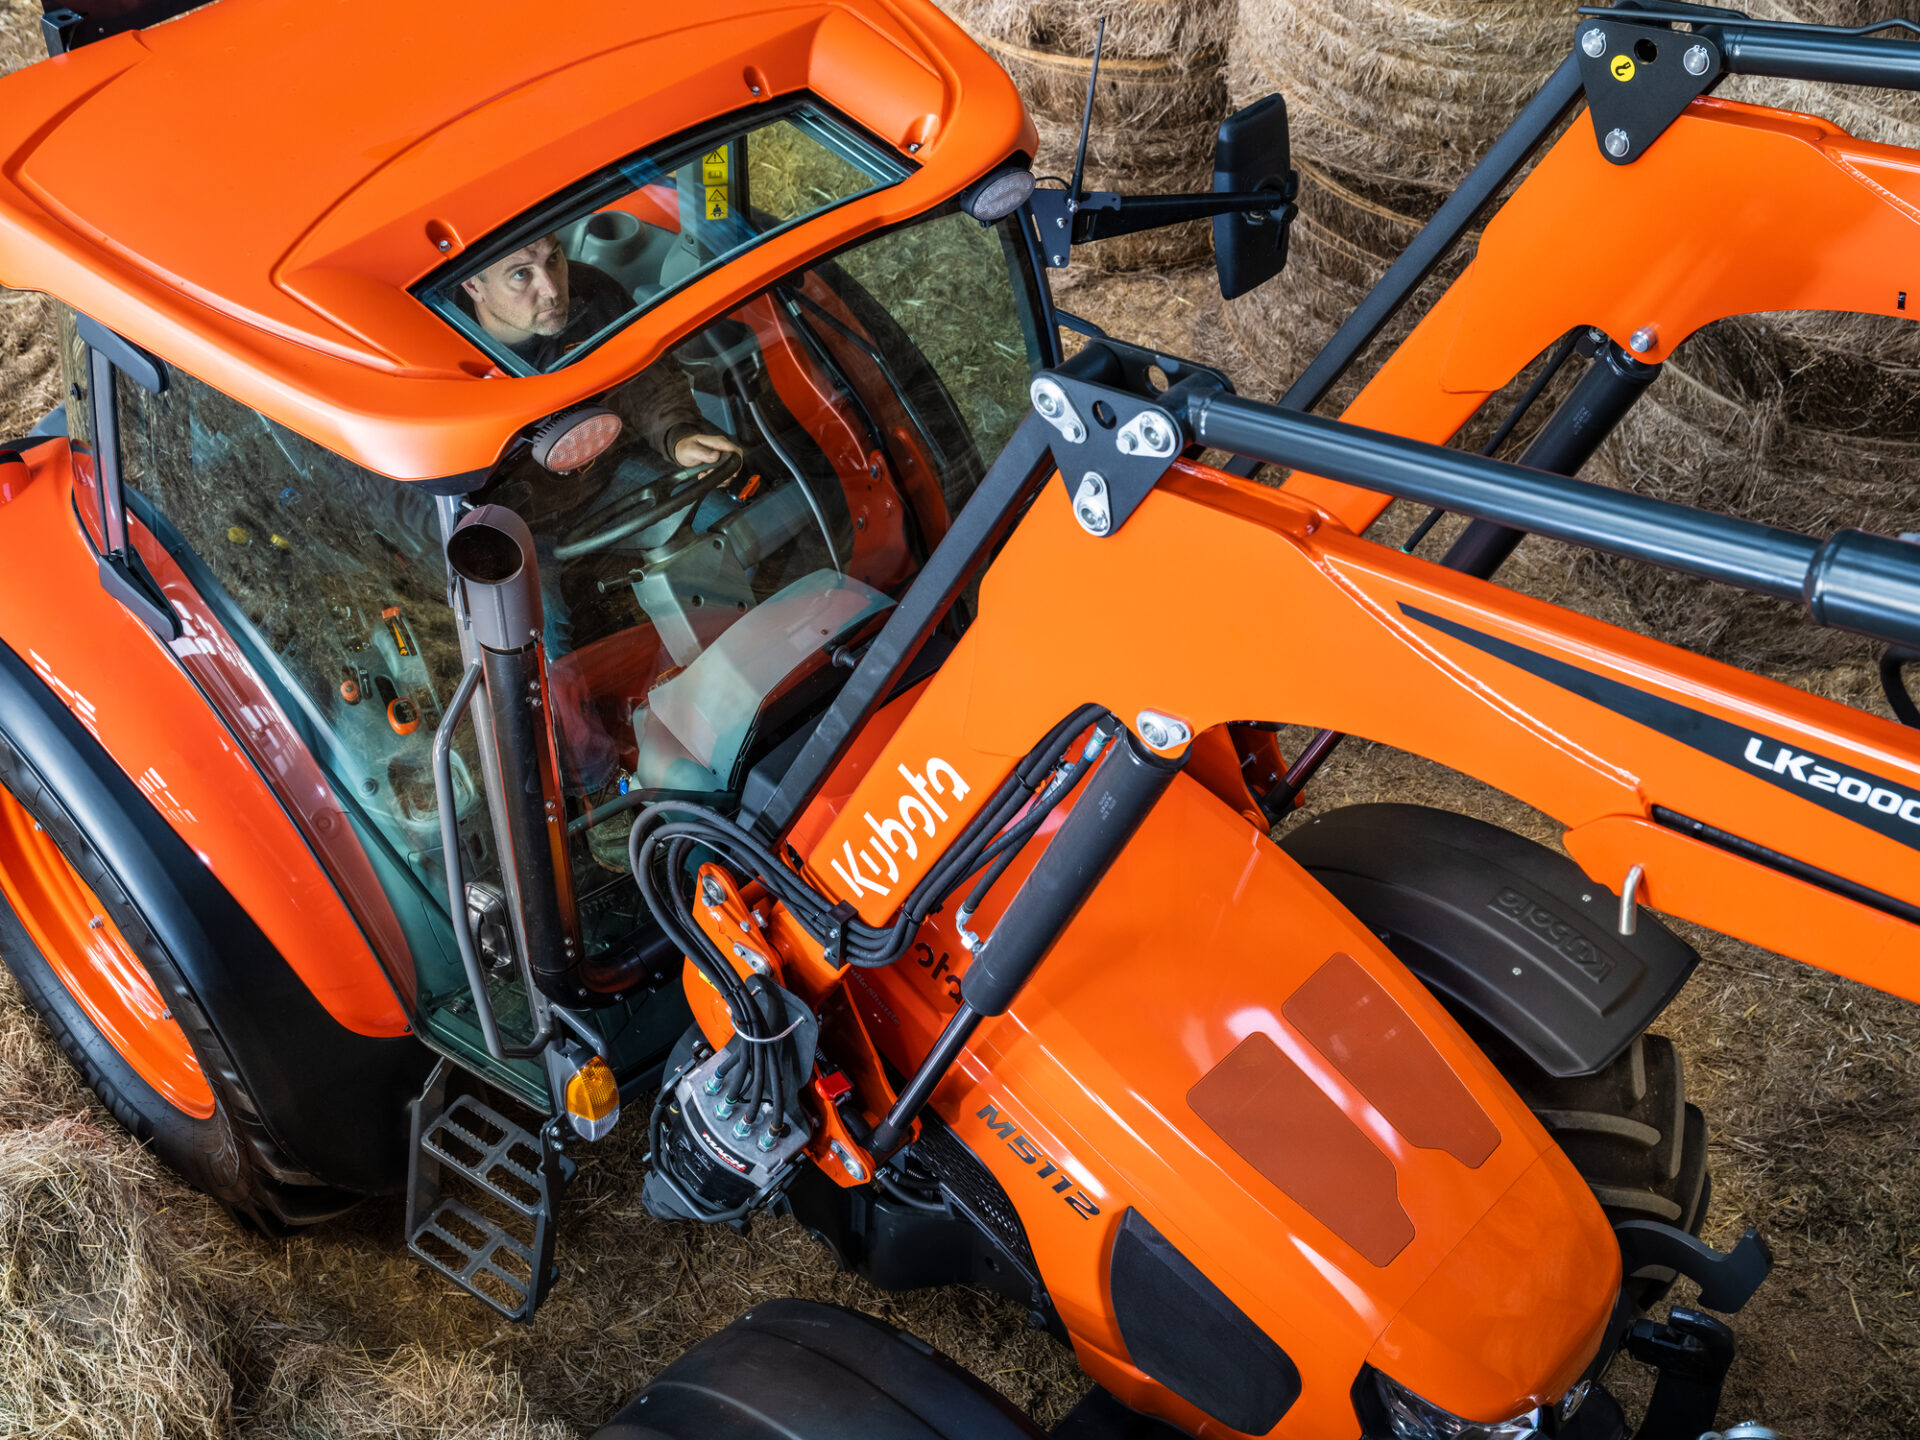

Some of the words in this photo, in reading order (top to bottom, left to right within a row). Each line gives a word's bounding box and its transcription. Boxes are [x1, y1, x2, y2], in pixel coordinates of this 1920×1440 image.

[830, 757, 971, 898] Kubota
[1744, 737, 1920, 826] LK2000
[914, 942, 963, 1005] ota
[1496, 888, 1612, 982] Kubota
[976, 1104, 1100, 1220] M5112
